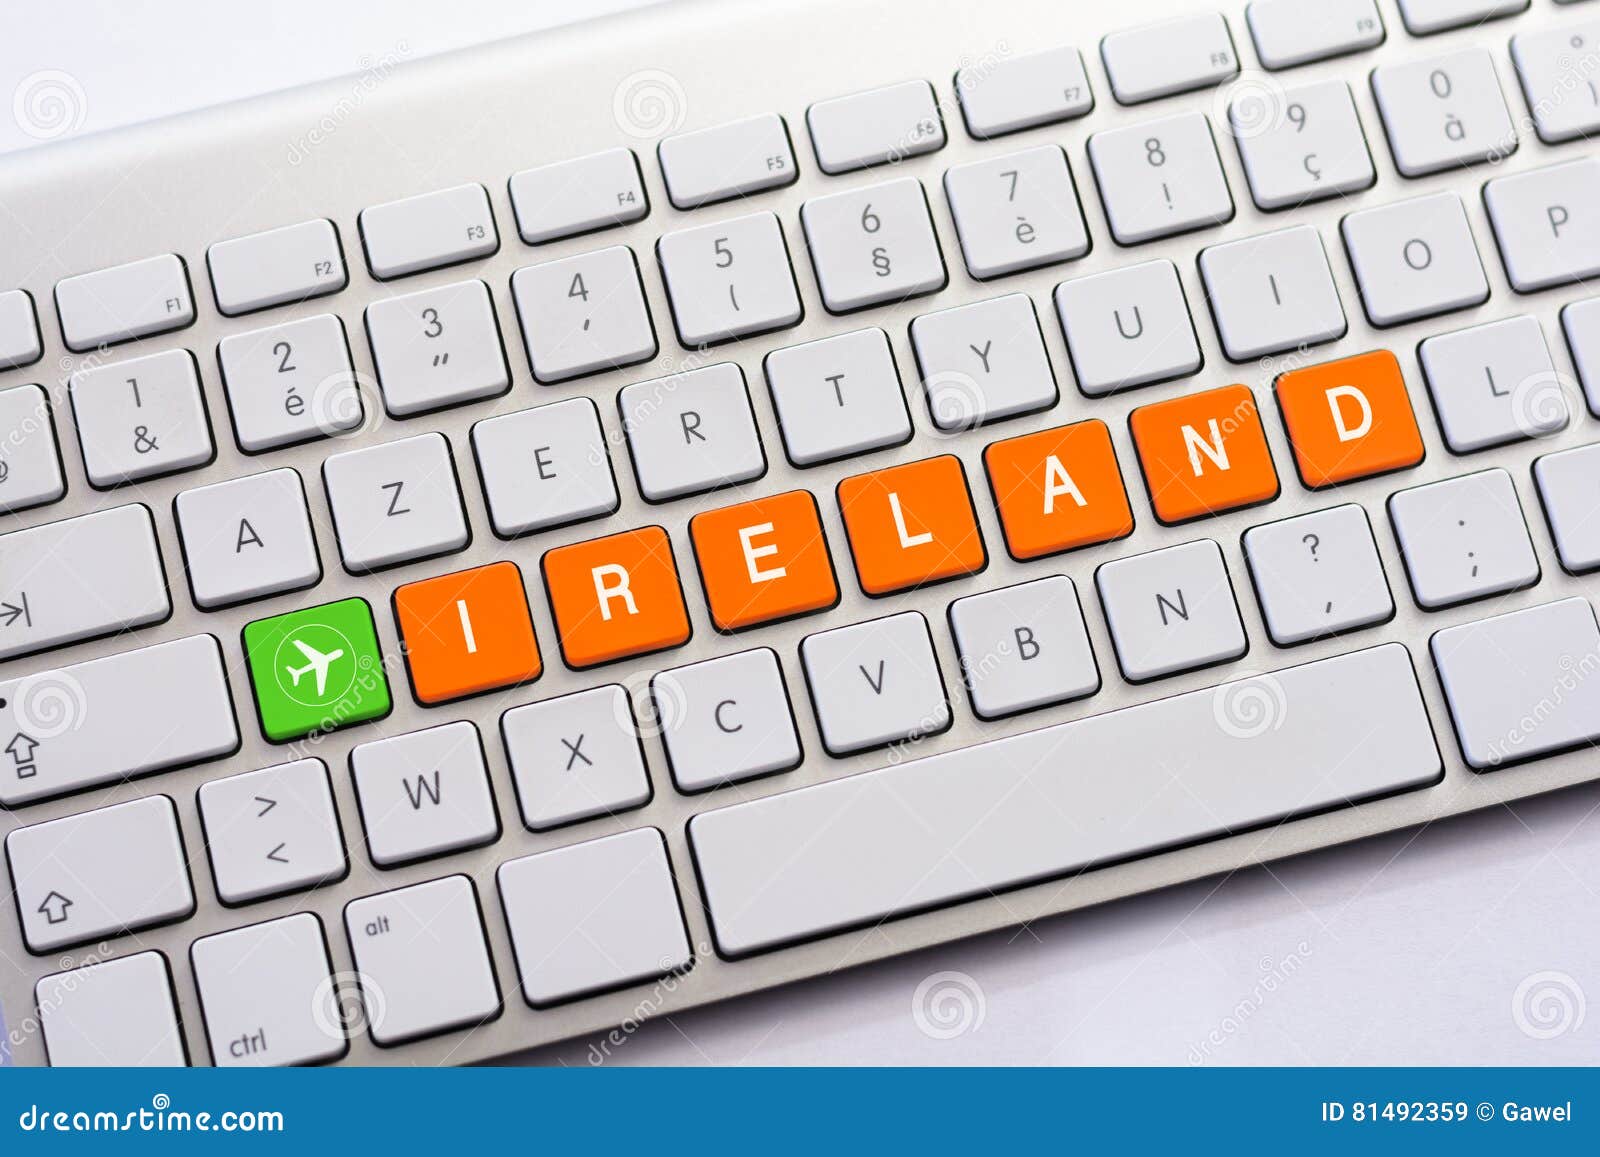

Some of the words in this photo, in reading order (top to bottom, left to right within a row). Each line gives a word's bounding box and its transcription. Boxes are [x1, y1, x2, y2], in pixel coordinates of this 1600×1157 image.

[1355, 17, 1375, 33] F9
[1209, 51, 1229, 67] F8
[1062, 86, 1082, 102] F7
[1286, 103, 1307, 133] 9
[1444, 114, 1466, 141] à
[765, 154, 786, 171] F5
[1144, 137, 1166, 167] 8
[1303, 153, 1321, 181] ç
[616, 190, 637, 207] F4
[999, 170, 1018, 202] 7
[465, 224, 486, 241] F3
[861, 203, 881, 234] 6
[1015, 216, 1036, 244] è
[1547, 205, 1569, 238] P
[714, 237, 733, 269] 5
[871, 247, 892, 277] §
[313, 260, 334, 278] F2
[567, 272, 589, 302] 4
[164, 296, 183, 313] F1
[421, 307, 443, 338] 3
[1113, 305, 1144, 340] U
[272, 341, 297, 373] 2
[969, 340, 992, 374] Y
[824, 374, 845, 407] T
[1485, 366, 1510, 398] L
[284, 386, 305, 417] é
[134, 425, 160, 454] &
[679, 411, 706, 445] R
[533, 446, 557, 480] E
[381, 481, 411, 517] Z
[236, 518, 264, 554] A
[1302, 533, 1320, 562] ?
[1155, 588, 1189, 626] N
[1014, 626, 1040, 661] B
[859, 659, 885, 695] V
[714, 699, 743, 734] C
[560, 733, 593, 771] X
[402, 770, 441, 810] W
[365, 916, 390, 937] alt
[229, 1028, 267, 1058] ctrl
